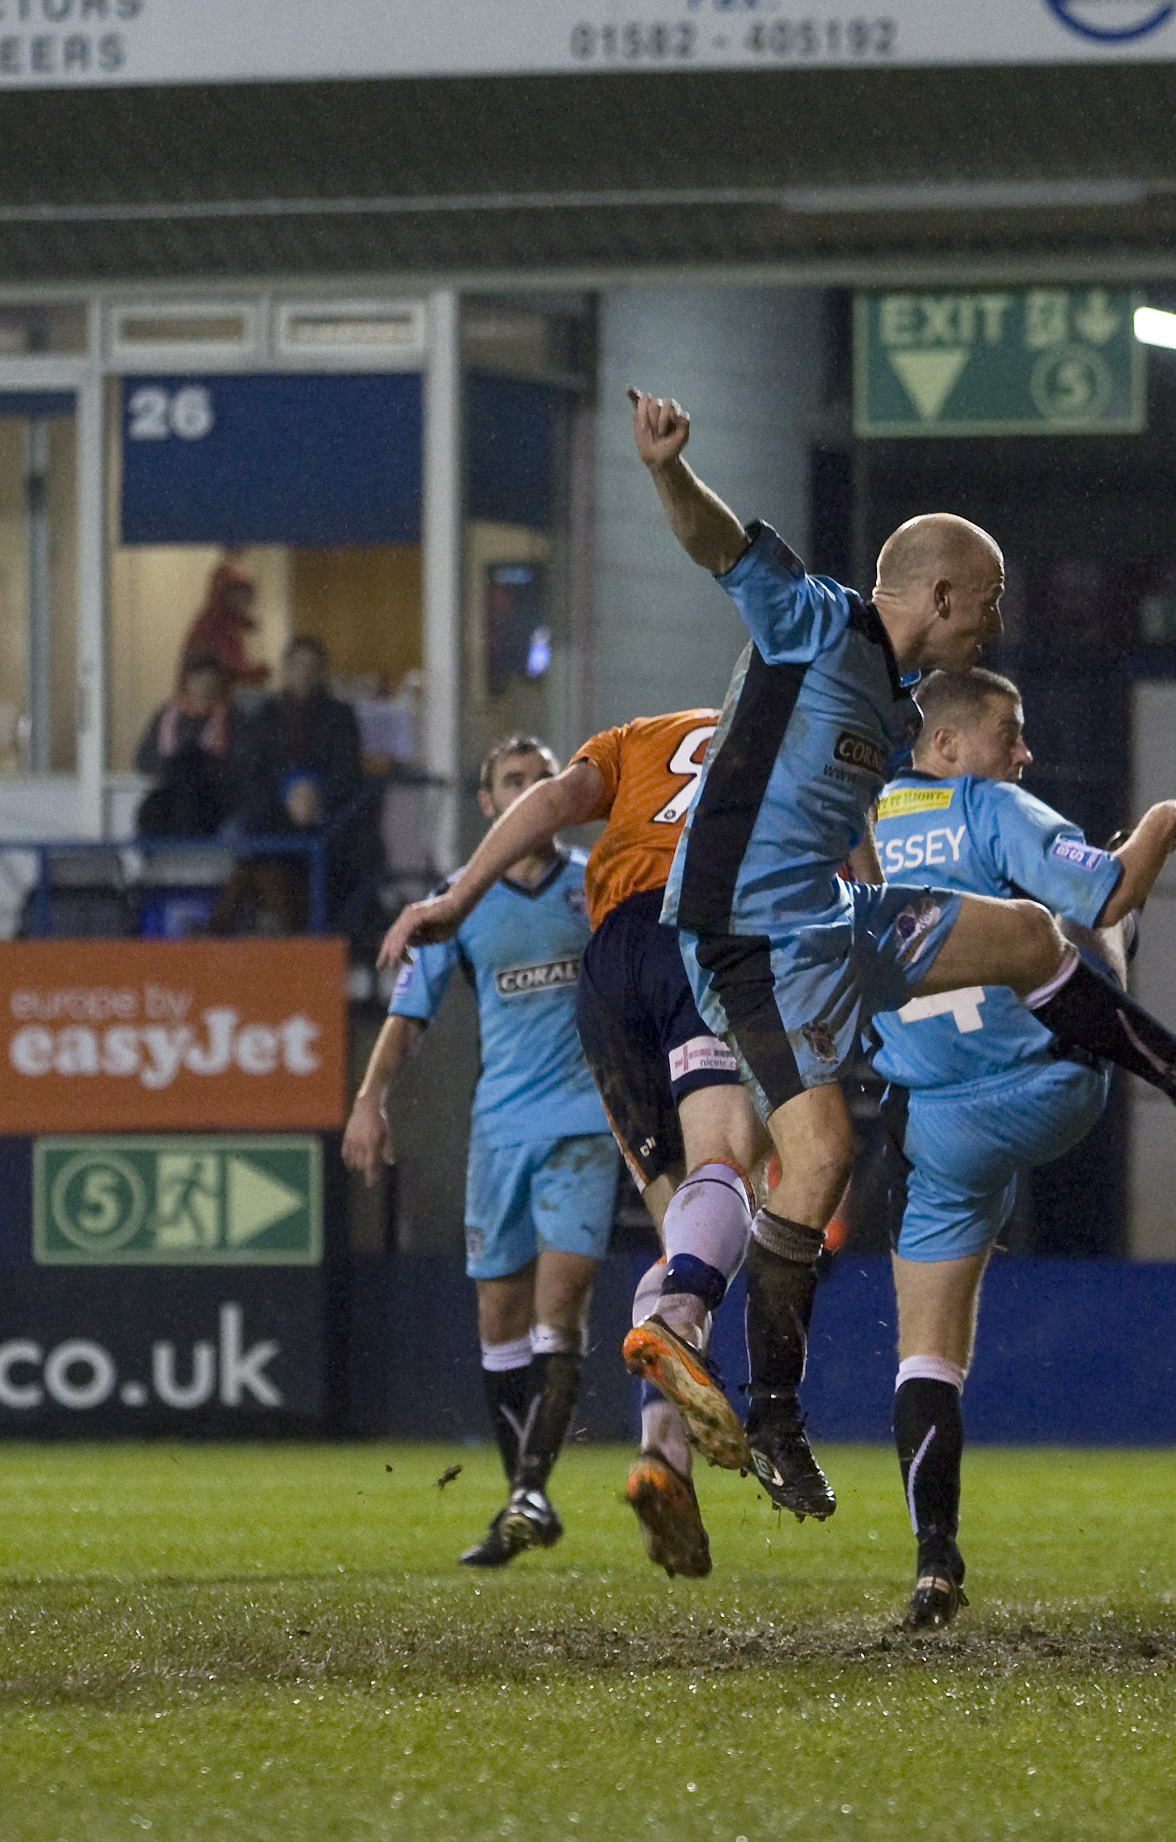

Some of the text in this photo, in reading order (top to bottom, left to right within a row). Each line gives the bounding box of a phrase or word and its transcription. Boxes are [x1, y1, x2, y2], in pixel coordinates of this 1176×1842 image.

[570, 21, 698, 59] 01582
[745, 17, 897, 55] 405192
[880, 294, 1012, 346] EXIT
[1056, 363, 1092, 406] 5
[128, 386, 215, 440] 26
[839, 739, 882, 771] CORA
[501, 961, 578, 992] CORAL
[10, 981, 192, 1023] europe by
[9, 1007, 318, 1089] easyJet
[76, 1172, 120, 1234] 5
[0, 1301, 283, 1410] co.uk
